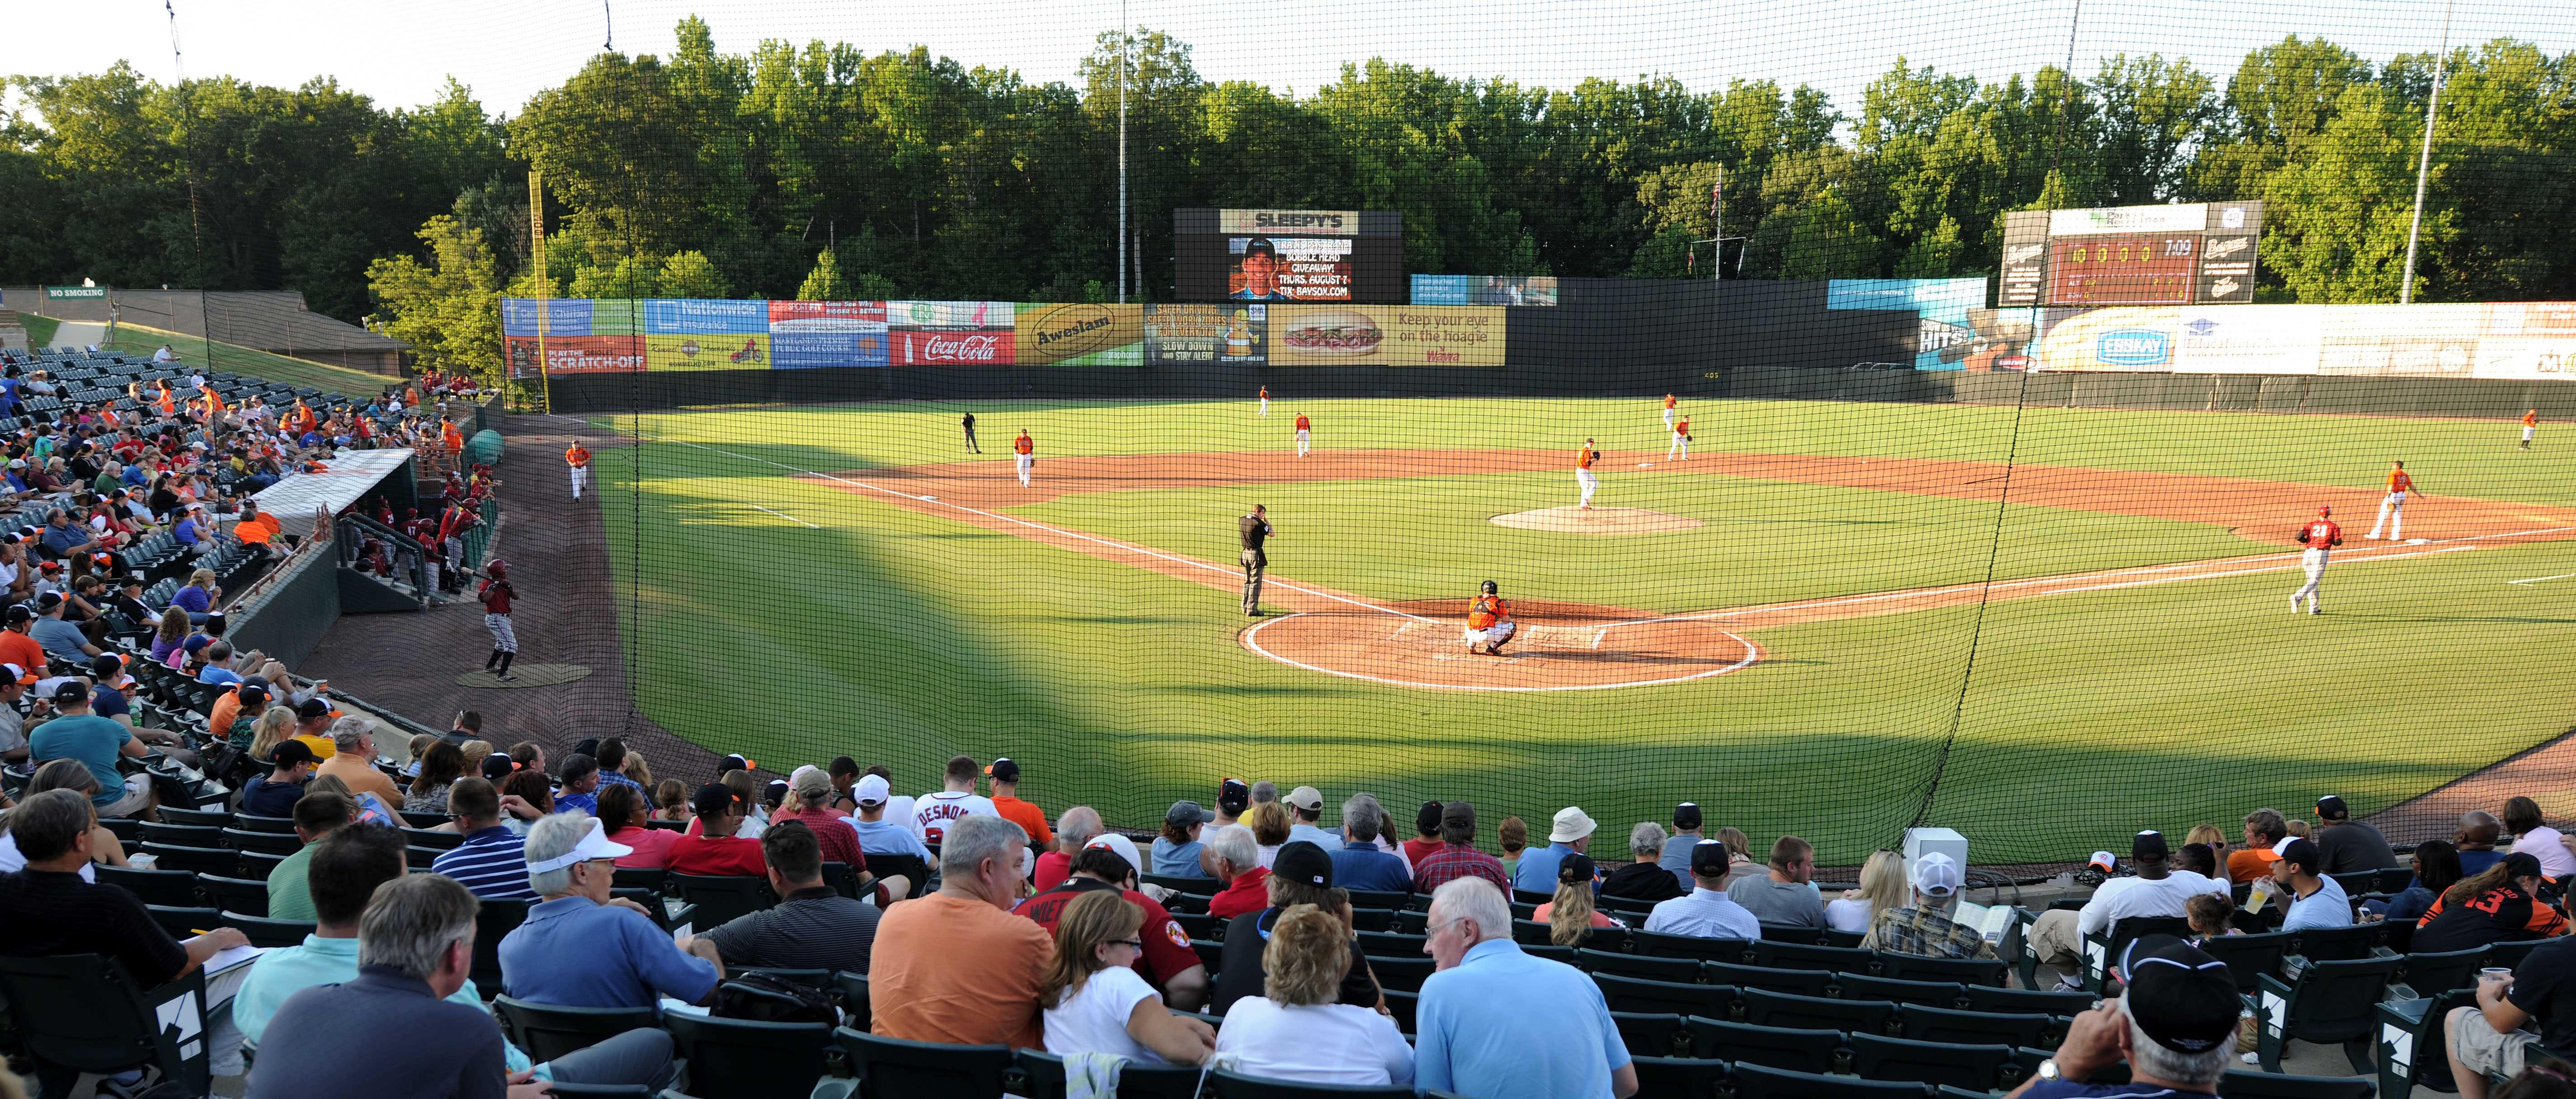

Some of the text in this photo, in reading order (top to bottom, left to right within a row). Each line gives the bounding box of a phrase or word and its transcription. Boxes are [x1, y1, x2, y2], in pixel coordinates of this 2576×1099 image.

[1256, 213, 1342, 227] SLEEPY'S
[1276, 240, 1349, 250] TRAVIS PASTRANA
[2073, 239, 2191, 263] 10 0 0 0 7:09
[1286, 253, 1340, 262] BOBBLE HEAD
[1292, 264, 1335, 272] GIVEAWAY!
[1279, 275, 1347, 284] THURS. AUGUST 7
[1280, 287, 1347, 296] TIX: BAYSOX.COM
[682, 301, 757, 315] Nationwide
[1157, 304, 1219, 315] SAFER DRIVING.
[683, 319, 727, 329] Insurance
[1147, 315, 1226, 326] SAFER WORK ZONES
[1399, 313, 1488, 329] Keep your eye
[1921, 319, 1940, 332] SHOW
[1941, 322, 1950, 332] US
[1037, 316, 1110, 345] Aweslam
[1158, 327, 1218, 337] FOR EVERYONE.
[1400, 329, 1487, 345] on the hoagie
[703, 343, 735, 354] Annapolis
[925, 335, 999, 360] Coca-Cola
[1162, 342, 1214, 351] SLOW DOWN
[2105, 338, 2161, 352] ESSKAY
[1107, 350, 1139, 360] graphcom
[1176, 352, 1192, 360] STAY
[1427, 349, 1460, 362] Wawa
[548, 356, 643, 370] SCRATCH-OFF
